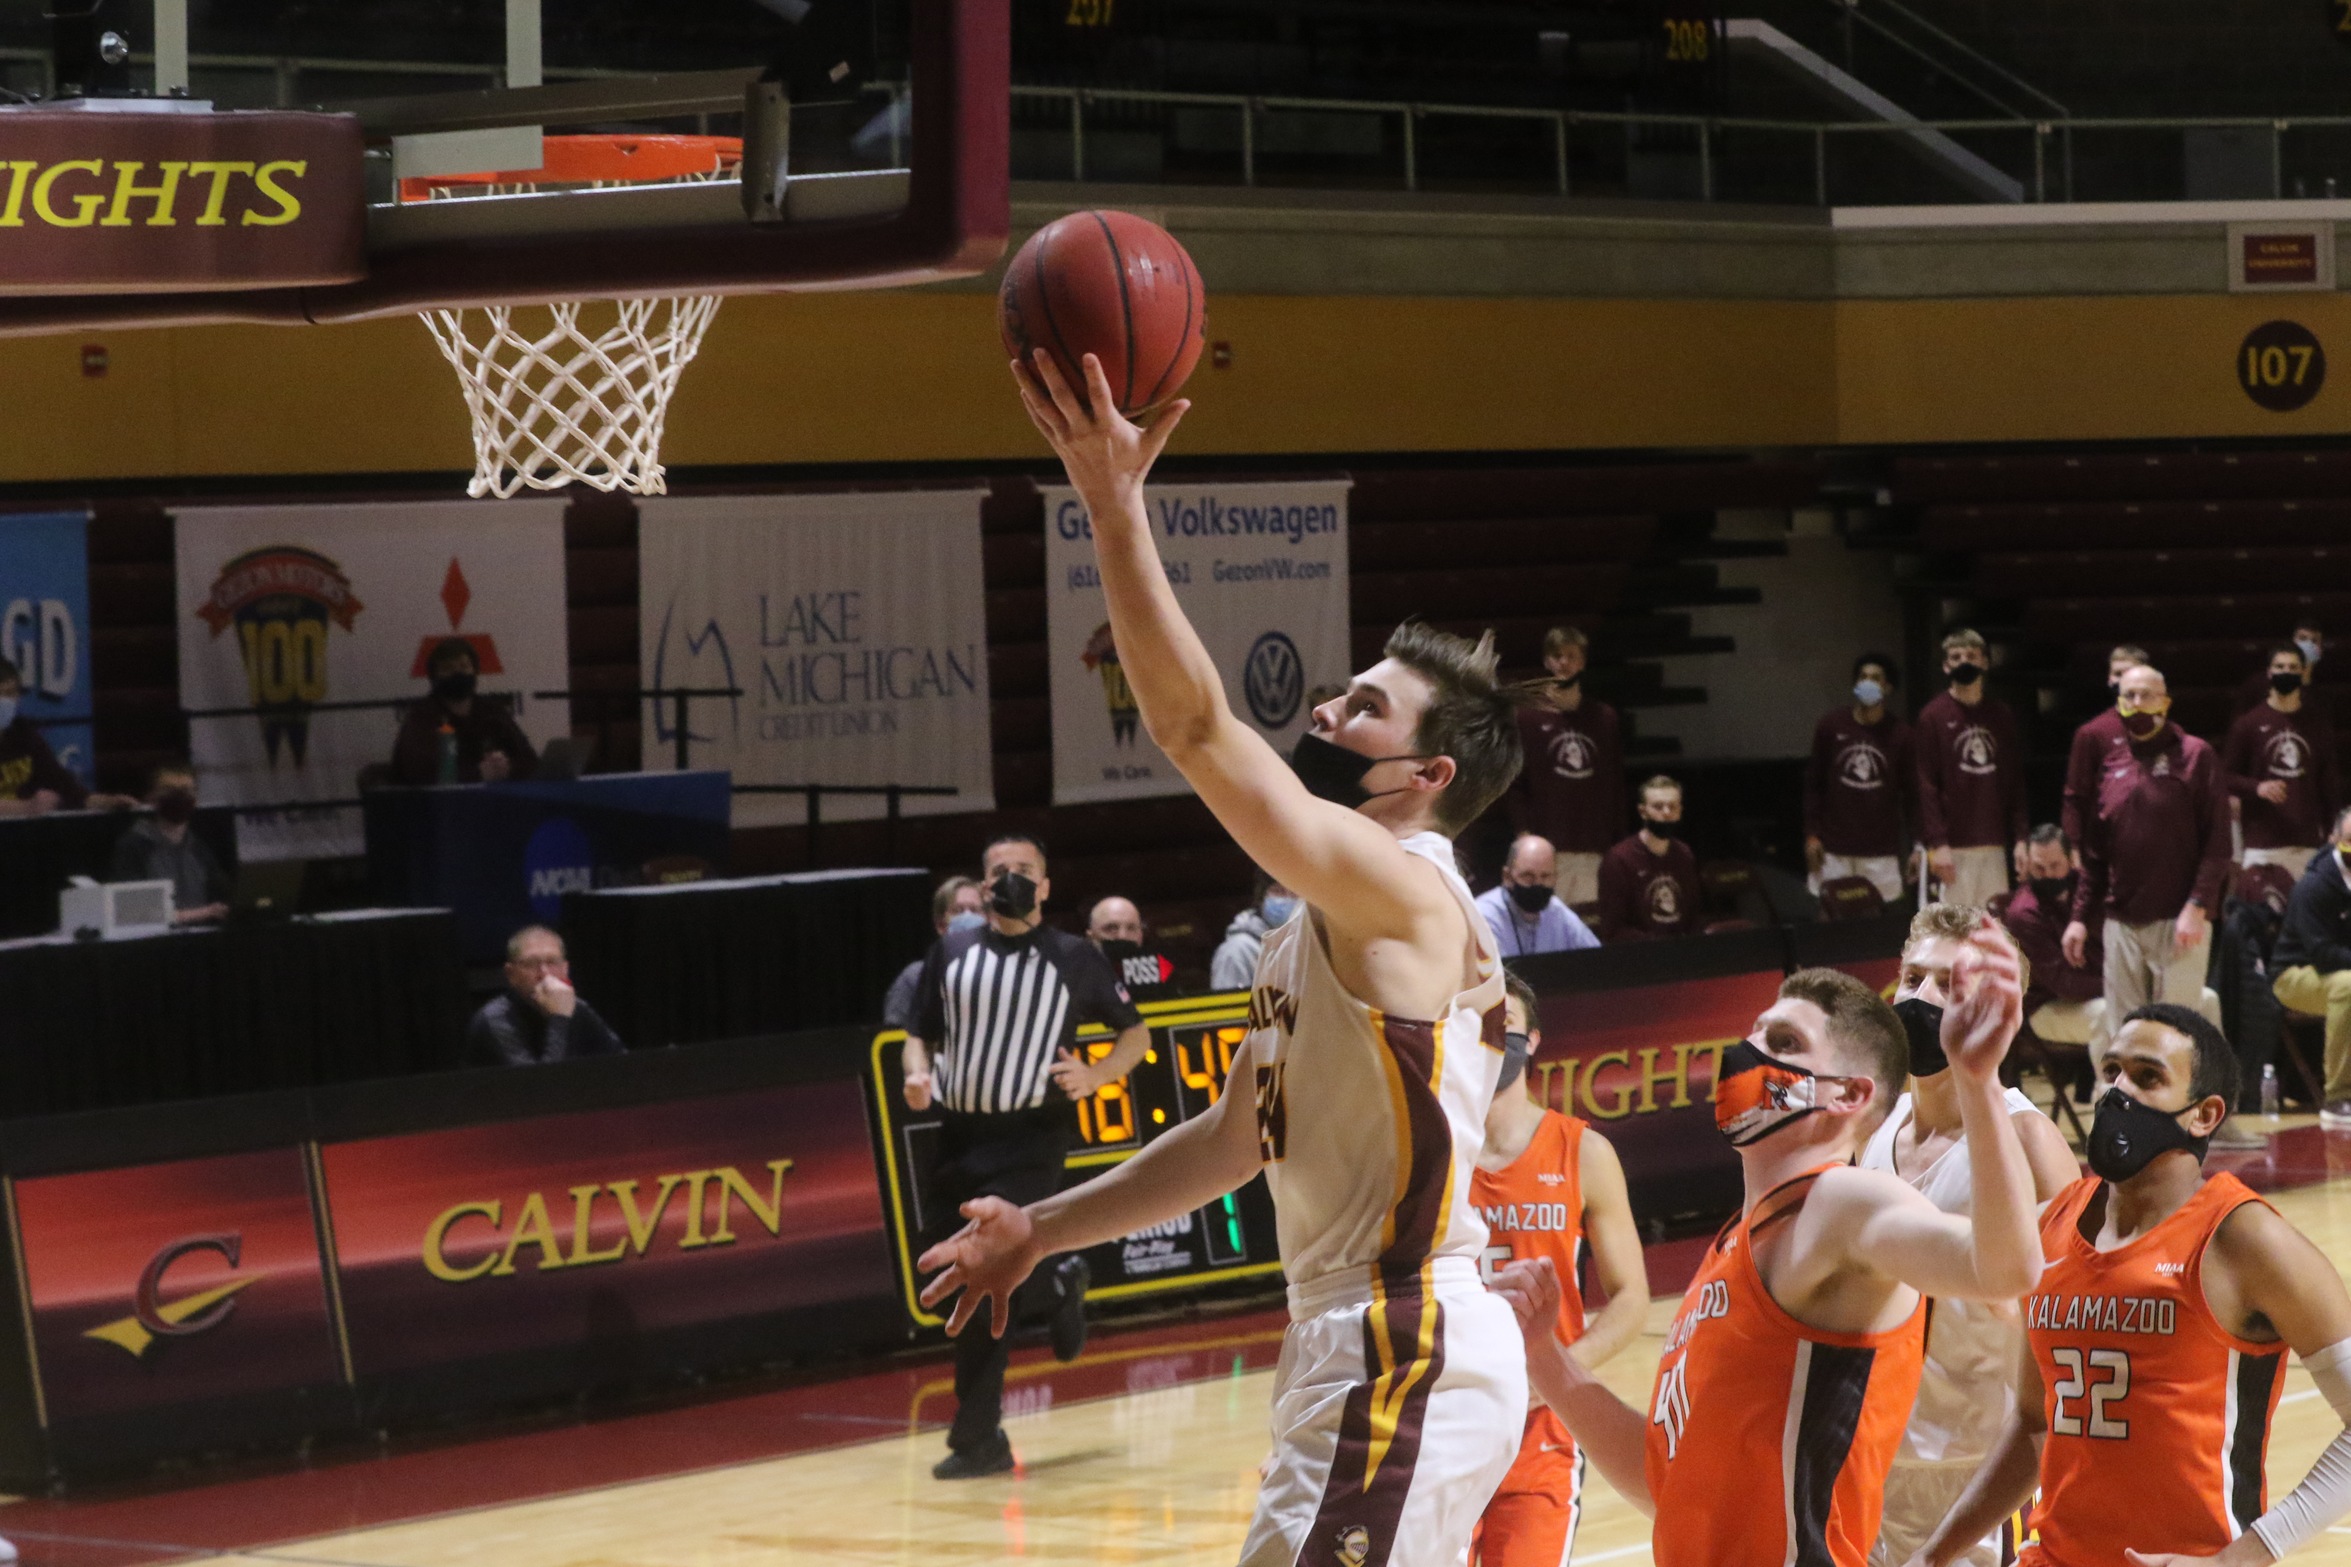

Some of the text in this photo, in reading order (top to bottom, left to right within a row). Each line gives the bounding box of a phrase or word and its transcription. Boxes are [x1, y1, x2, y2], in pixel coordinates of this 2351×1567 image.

[1663, 18, 1708, 61] 208
[0, 158, 308, 228] IGHTS
[2246, 345, 2315, 387] 107
[1159, 497, 1338, 544] Volkswagen
[1213, 557, 1332, 582] GezonVW.com
[759, 591, 861, 648] LAKE
[241, 617, 328, 705] 100
[759, 643, 977, 708] MICHIGAN
[1121, 954, 1160, 986] POSS
[422, 1159, 794, 1282] CALVIN
[2153, 1262, 2185, 1273] MIAA
[2027, 1294, 2177, 1335] KALAMAZOO
[2051, 1346, 2132, 1441] 22
